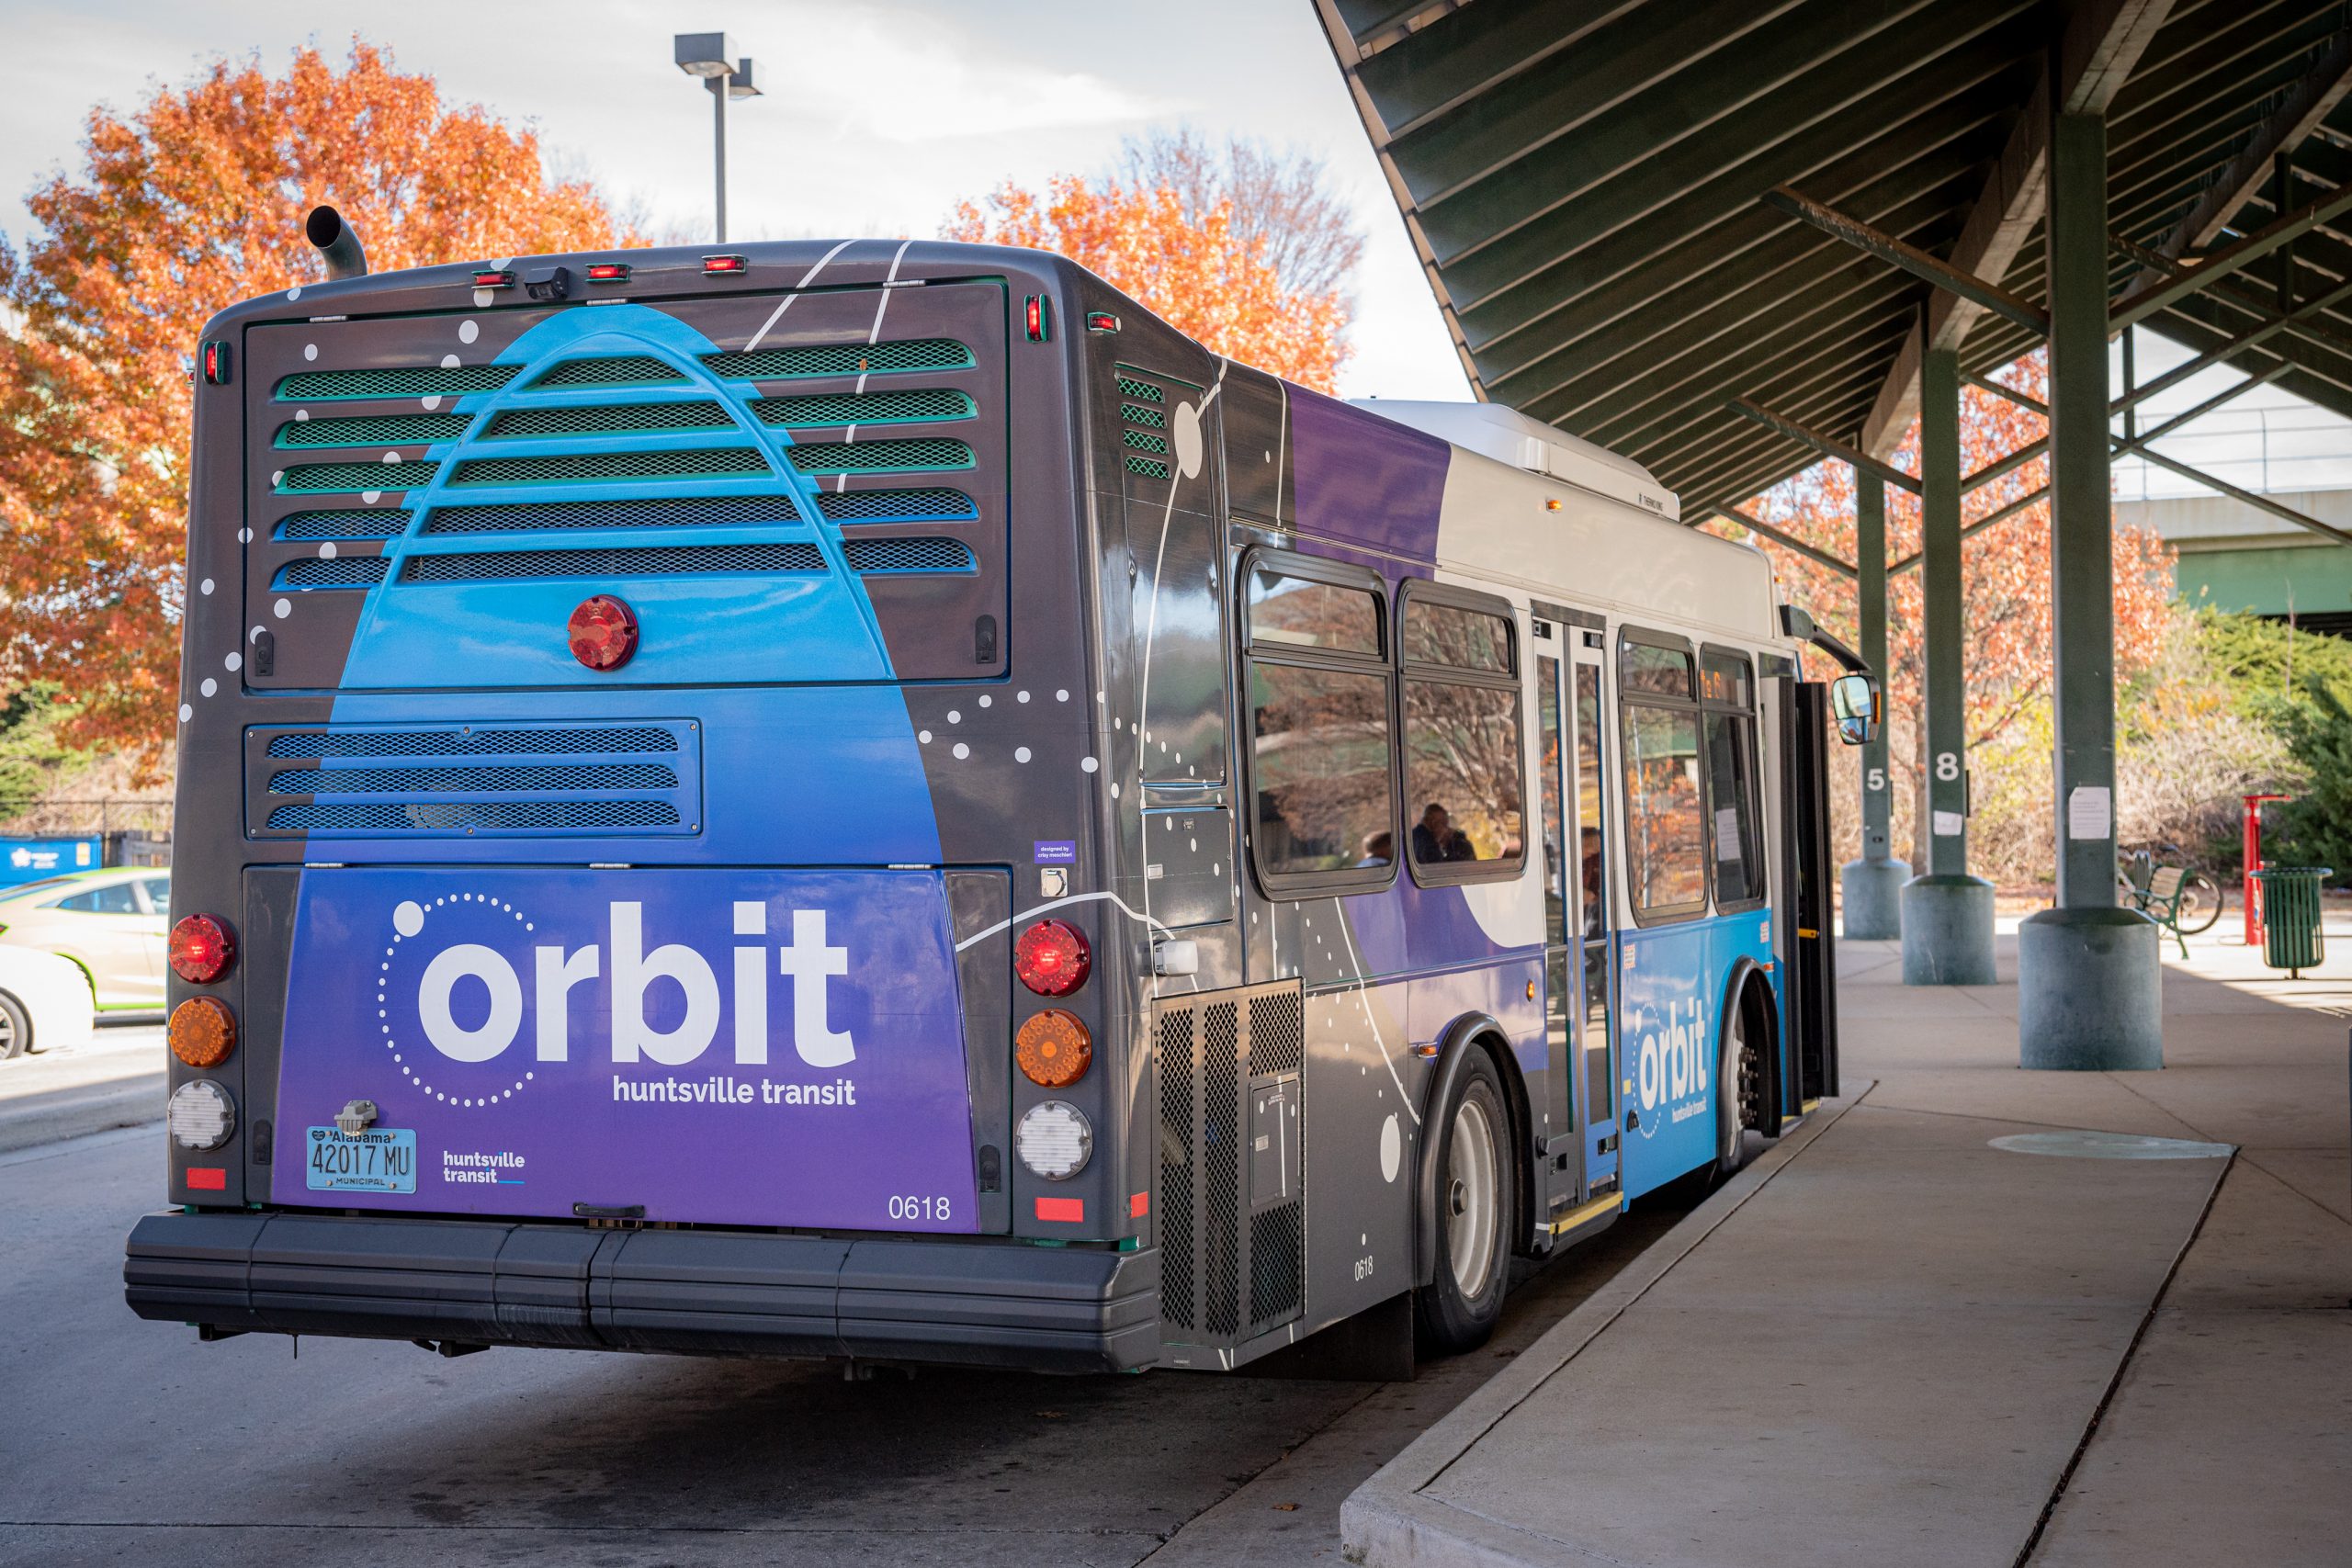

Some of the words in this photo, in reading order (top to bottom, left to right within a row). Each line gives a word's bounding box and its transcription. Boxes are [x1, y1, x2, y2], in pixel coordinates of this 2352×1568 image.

[1867, 768, 1884, 791] 5
[1936, 752, 1959, 781] 8
[419, 901, 855, 1068] orbit
[1639, 997, 1707, 1111] orbit
[613, 1076, 753, 1105] huntsville
[762, 1078, 856, 1106] transit
[1672, 1102, 1693, 1123] huntsville
[1693, 1096, 1707, 1115] transit
[332, 1131, 390, 1144] Alabama
[312, 1144, 377, 1175] 42017
[385, 1146, 410, 1176] MU
[443, 1150, 526, 1168] huntsville
[335, 1178, 386, 1186] MUNICIPAL
[443, 1167, 498, 1183] transit
[888, 1195, 951, 1221] 0618
[1354, 1255, 1374, 1281] 0618
